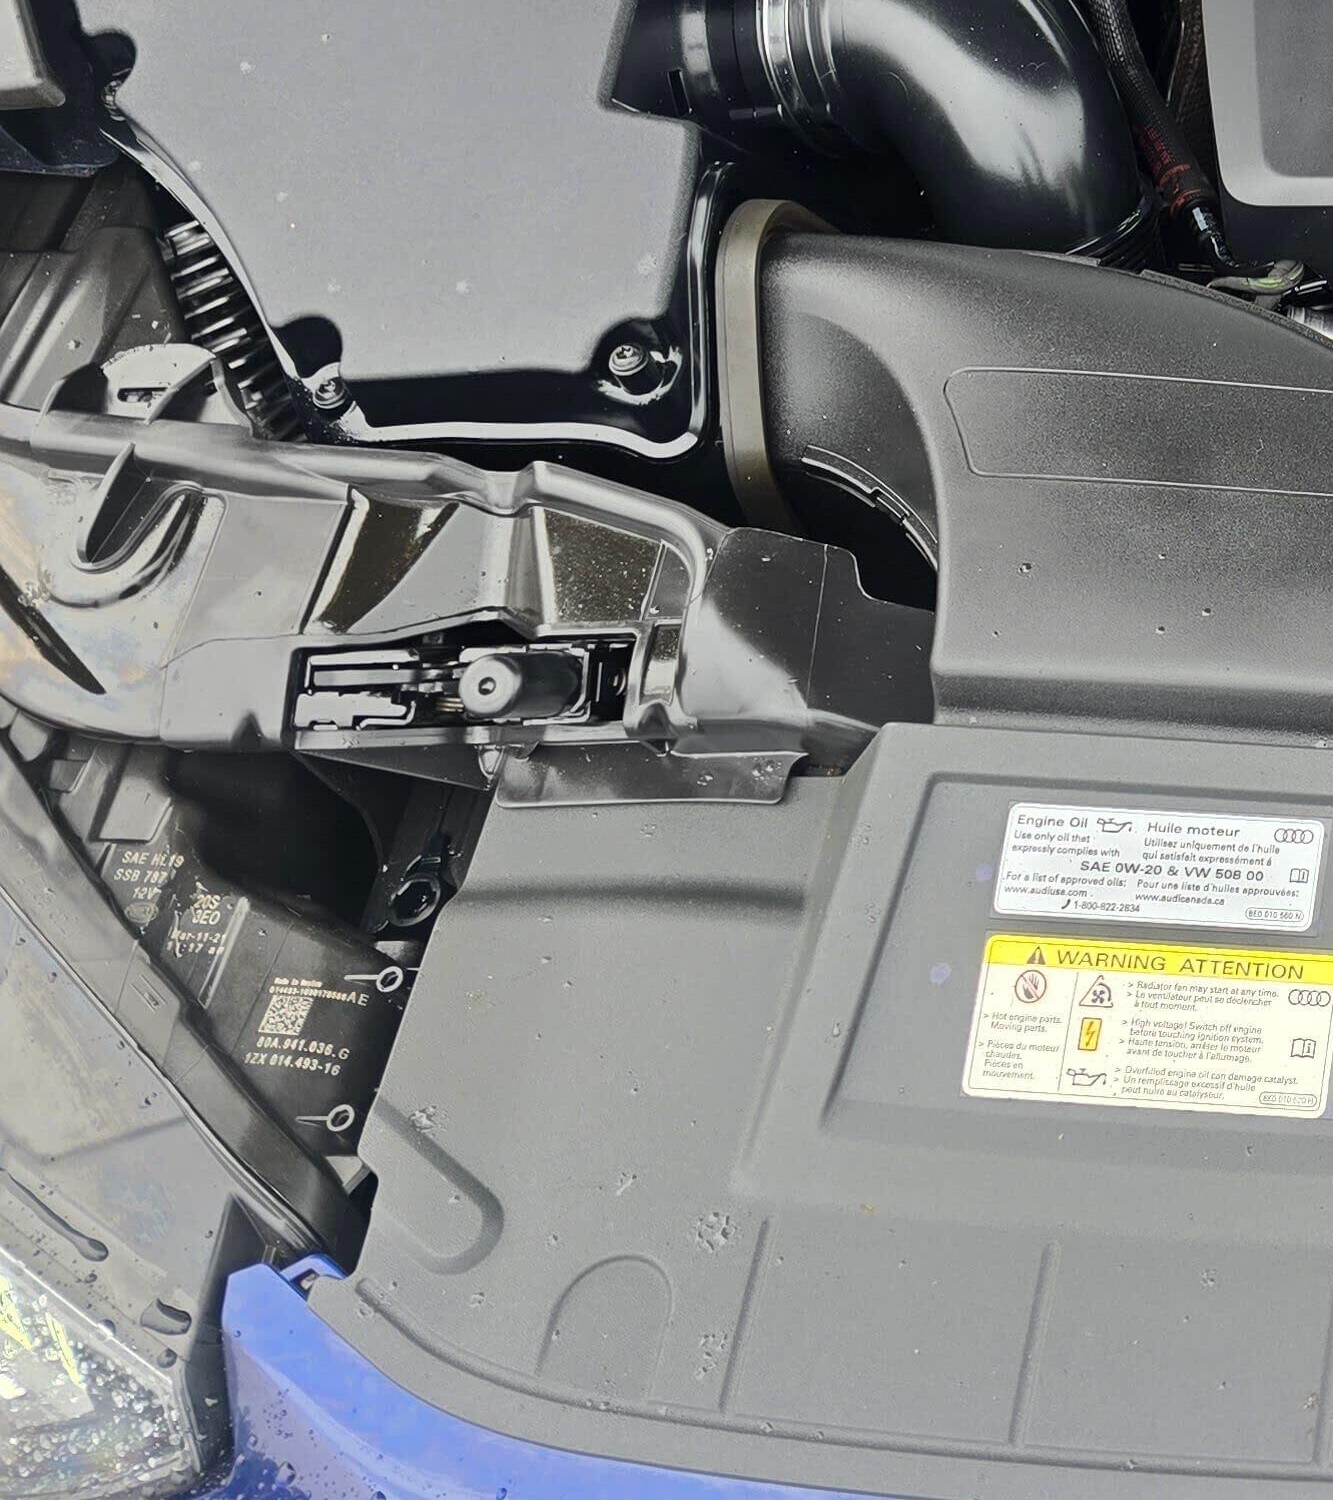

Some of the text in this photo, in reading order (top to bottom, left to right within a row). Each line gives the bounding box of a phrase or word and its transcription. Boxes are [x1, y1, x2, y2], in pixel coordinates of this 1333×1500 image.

[1017, 814, 1089, 828] Engine Oil
[1013, 830, 1090, 844] Use only oil that
[1147, 822, 1241, 838] Huile moteur
[1012, 843, 1120, 858] expressly complies with
[1144, 837, 1178, 849] Utilisez
[1180, 839, 1236, 853] uniquement
[1237, 843, 1250, 853] de
[121, 850, 150, 865] SAE
[1142, 851, 1158, 862] qui
[1159, 851, 1196, 862] satisfait
[113, 868, 141, 882] SSB
[1005, 871, 1022, 881] For
[1032, 872, 1047, 882] list
[1048, 873, 1060, 883] of
[1060, 875, 1105, 886] approved
[1080, 861, 1264, 882] SAE 0W-20 & VW 508 00
[1137, 878, 1160, 889] Pour
[1161, 881, 1179, 890] une
[1181, 881, 1201, 892] liste
[193, 894, 222, 910] 20S
[1057, 950, 1305, 980] WARNING ATTENTION
[1173, 982, 1188, 993] fan
[1189, 985, 1208, 996] may
[1209, 986, 1229, 996] start
[1240, 989, 1257, 999] any
[346, 991, 370, 1007] AE
[991, 1011, 1008, 1021] Hot
[1008, 1013, 1038, 1024] engine
[990, 1021, 1023, 1033] Moving
[1188, 1021, 1218, 1032] Switch
[1219, 1023, 1232, 1032] off
[1015, 1042, 1027, 1051] du
[1028, 1044, 1060, 1053] moteur
[243, 1051, 269, 1065] 1ZX
[1012, 1062, 1023, 1070] en
[1123, 1074, 1138, 1084] Un
[1167, 1067, 1197, 1079] engine
[1210, 1071, 1226, 1081] can
[1227, 1072, 1263, 1085] damage
